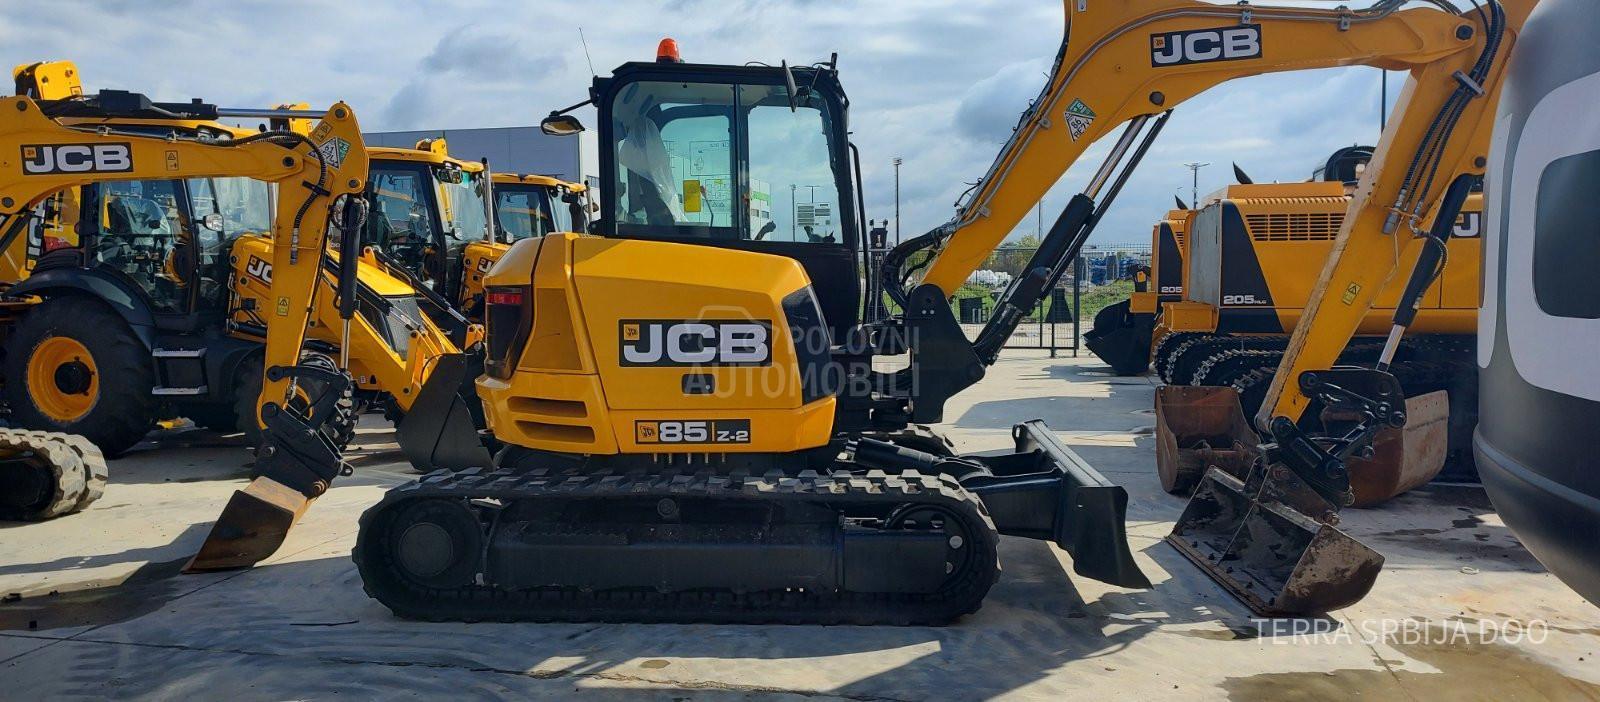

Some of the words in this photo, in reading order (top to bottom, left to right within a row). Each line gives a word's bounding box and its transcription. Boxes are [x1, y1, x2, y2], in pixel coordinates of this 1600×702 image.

[1153, 28, 1260, 64] JCB
[25, 145, 131, 173] JCB
[247, 260, 273, 283] JC
[1223, 295, 1255, 304] 205
[623, 323, 768, 363] JCB
[660, 421, 708, 442] 85
[716, 430, 749, 442] Z-2
